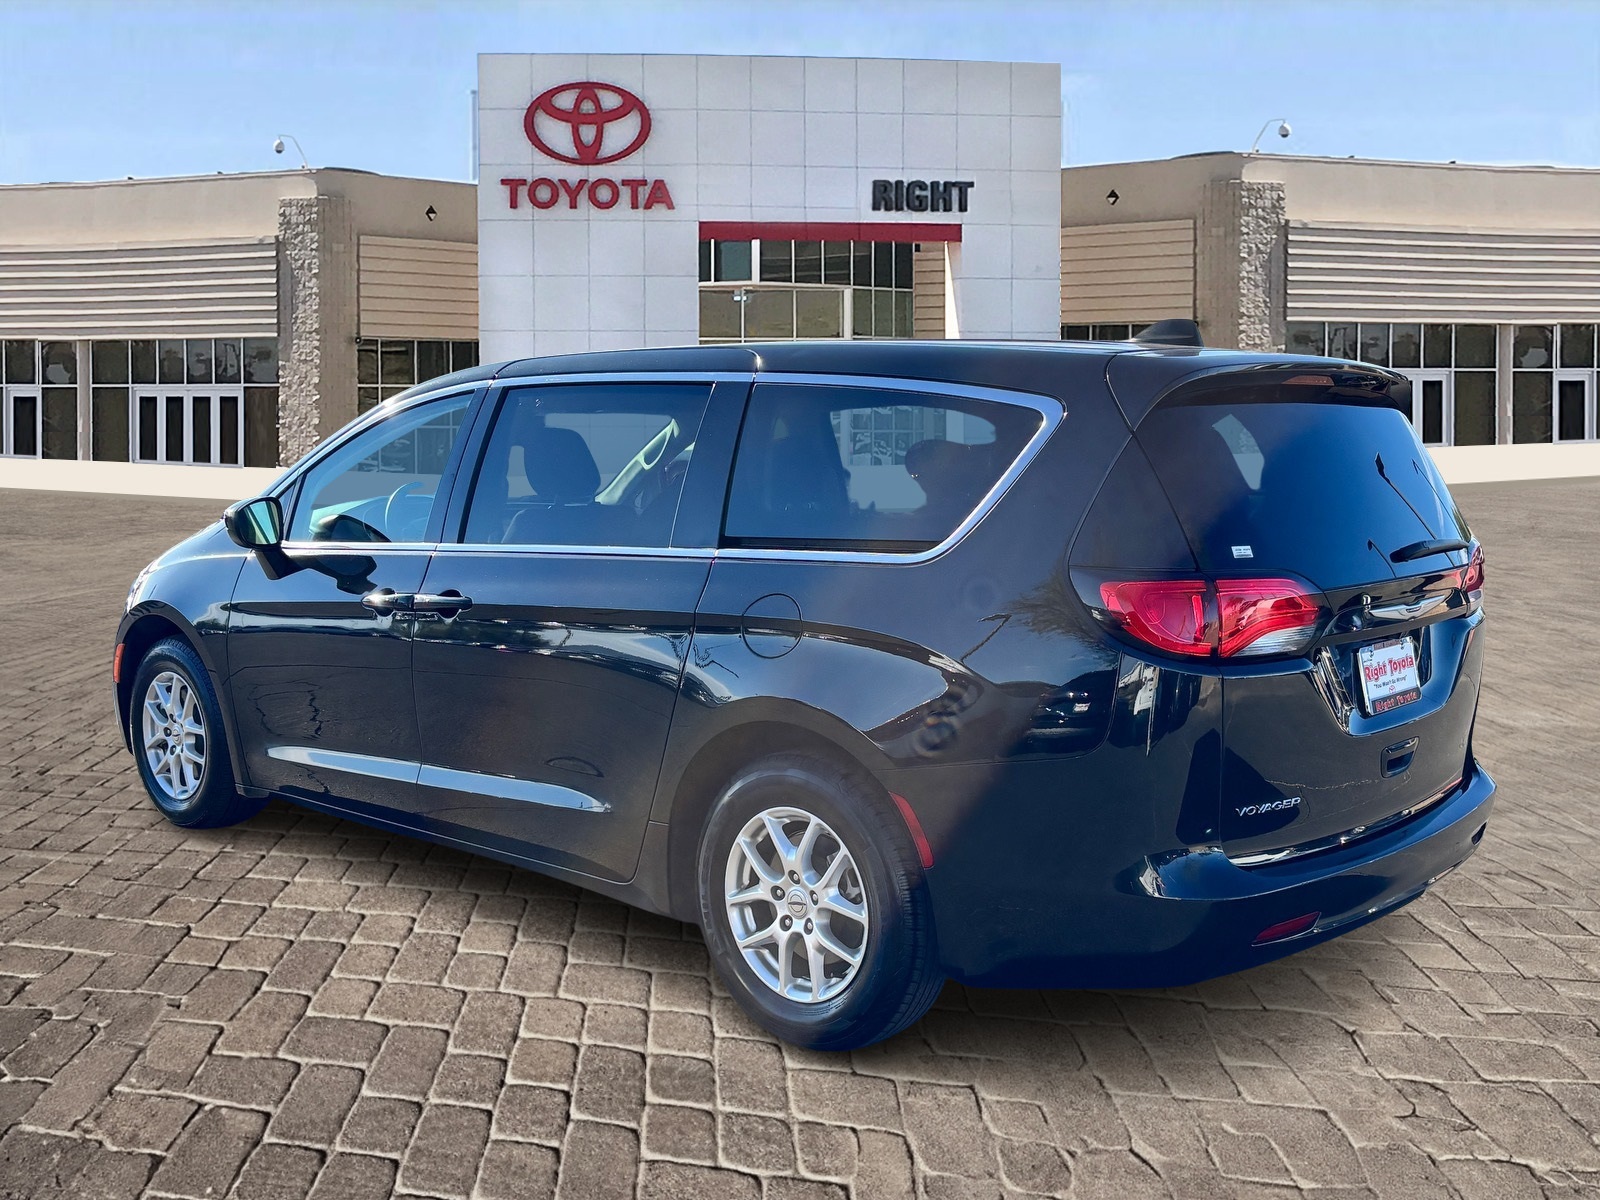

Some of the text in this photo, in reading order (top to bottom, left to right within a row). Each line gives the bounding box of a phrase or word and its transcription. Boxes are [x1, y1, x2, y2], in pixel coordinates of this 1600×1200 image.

[501, 178, 675, 210] TOYOTA
[872, 180, 974, 212] RIGHT
[1364, 655, 1414, 682] Right Toyota
[1375, 692, 1417, 712] Right Toyota
[1235, 797, 1302, 816] VOYAGER
